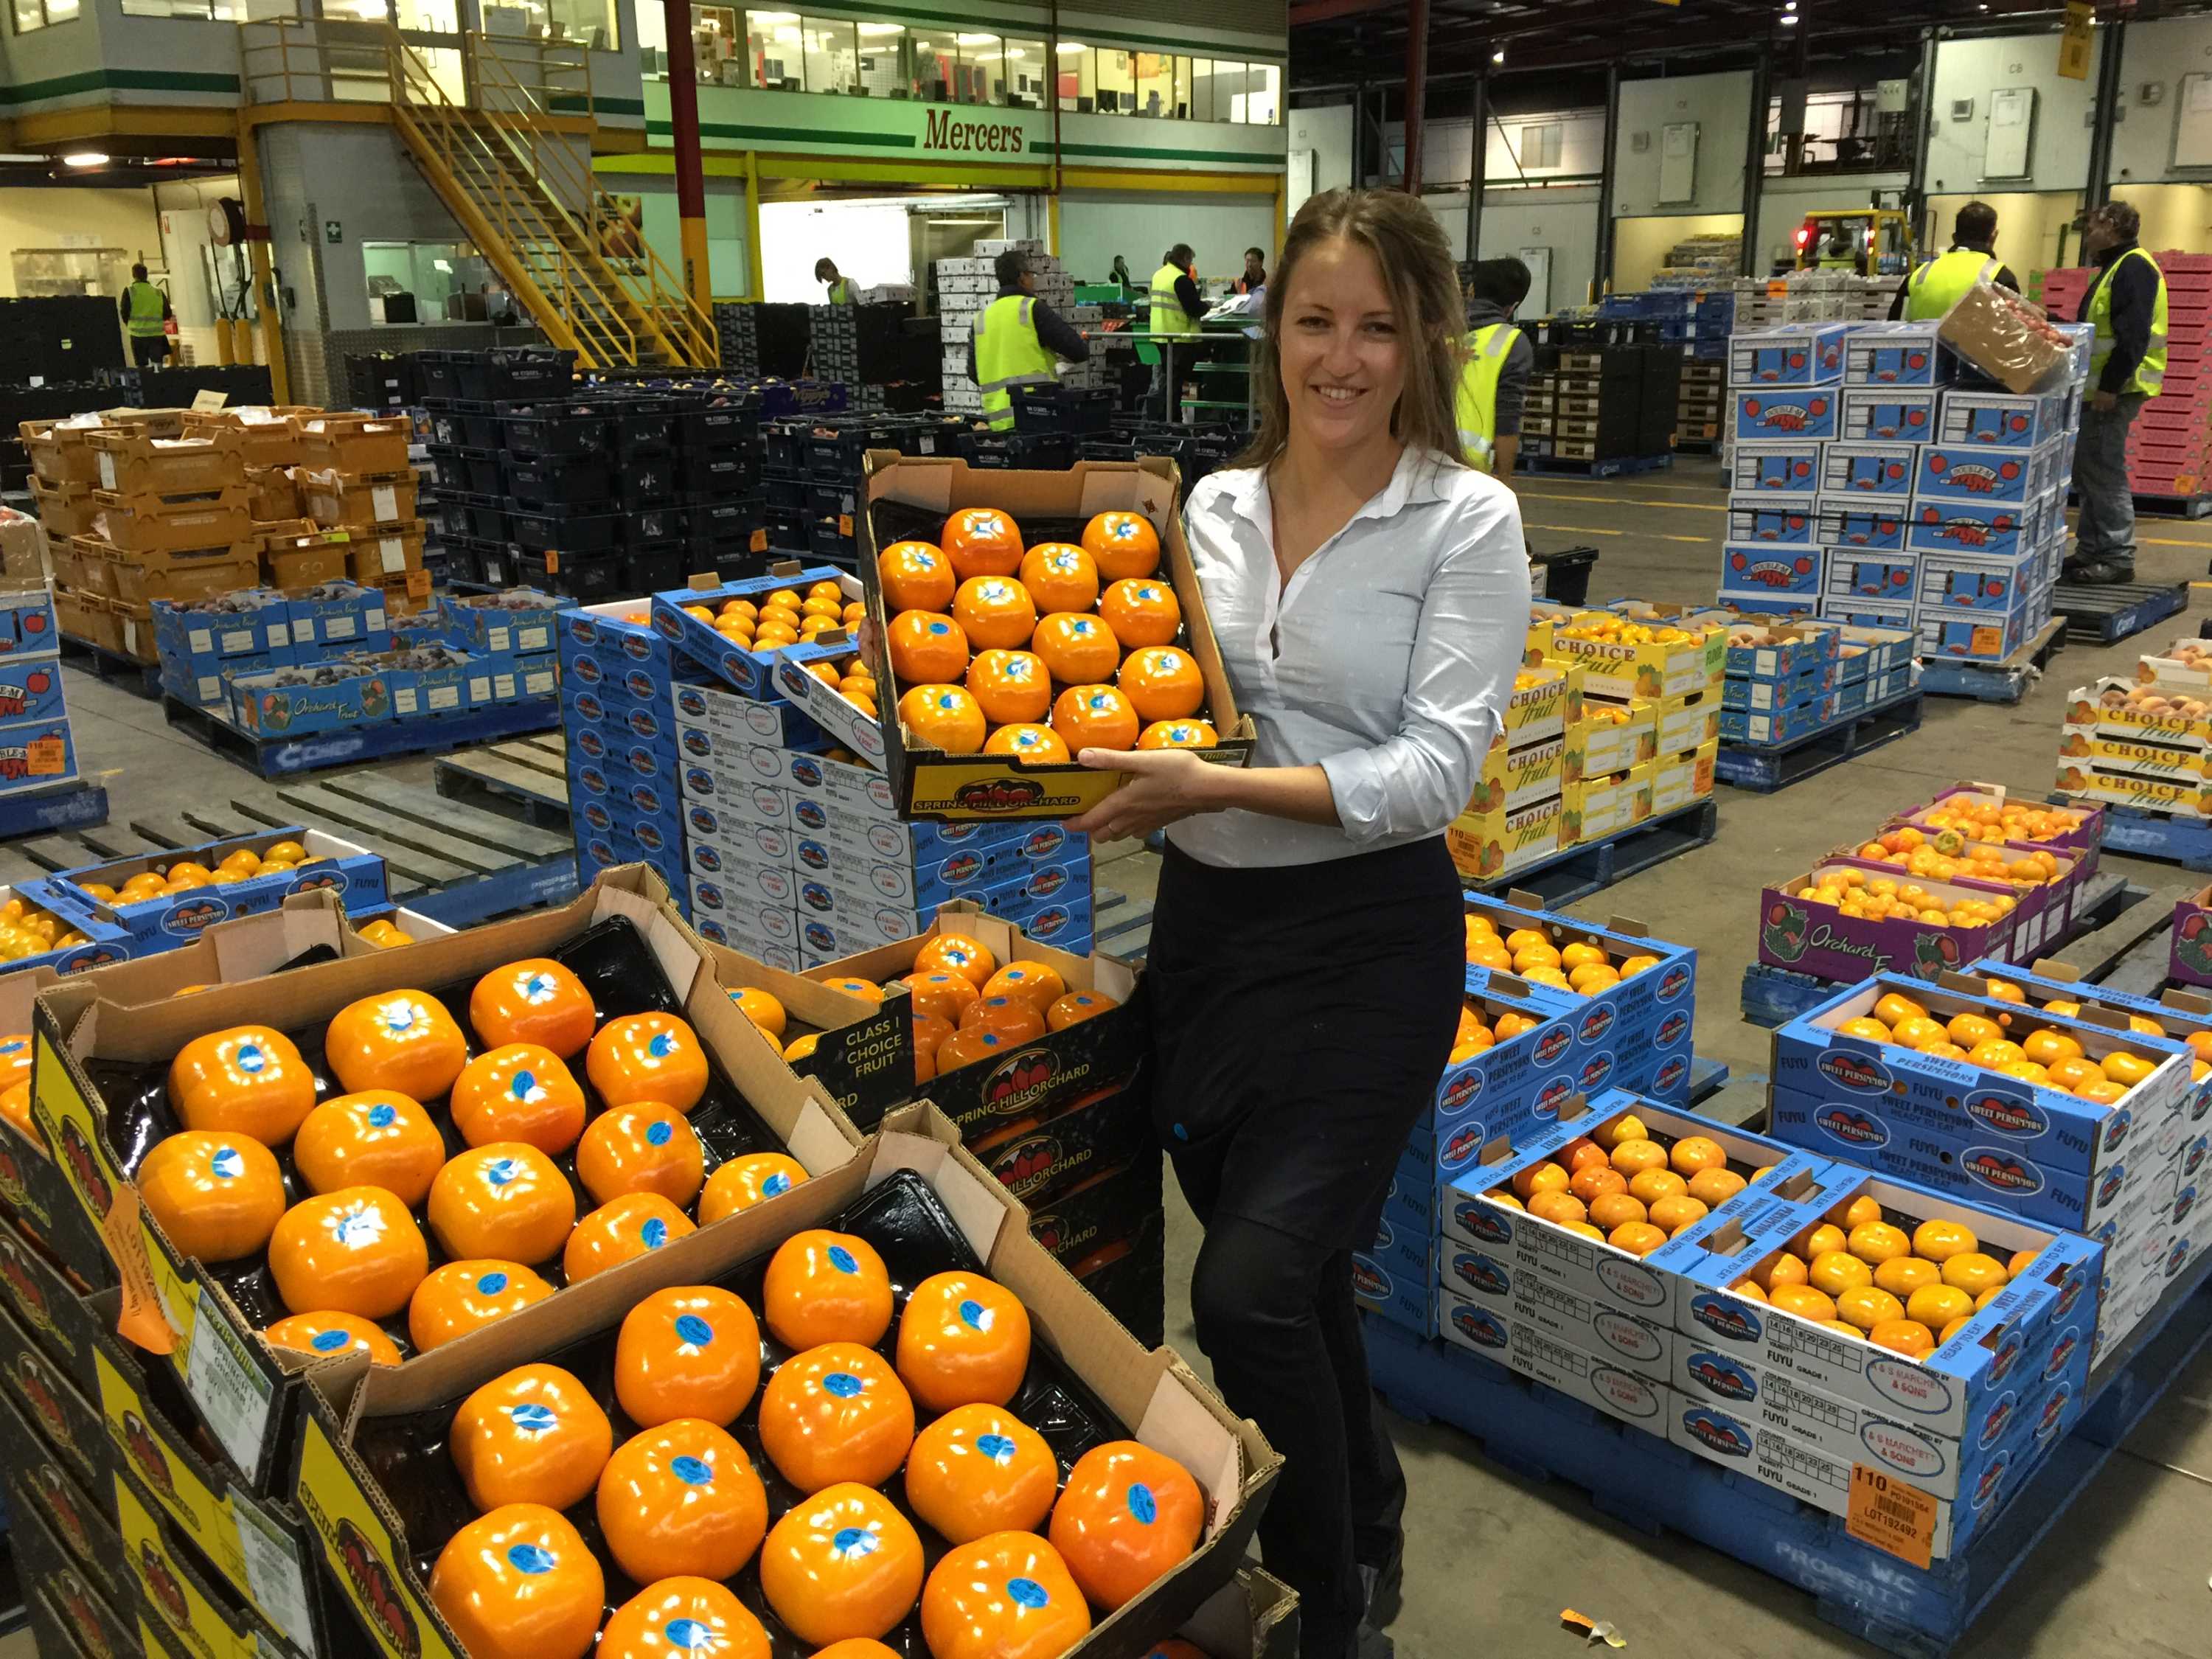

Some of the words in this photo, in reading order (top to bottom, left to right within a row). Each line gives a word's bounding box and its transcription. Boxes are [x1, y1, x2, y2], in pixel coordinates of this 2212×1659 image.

[923, 108, 1023, 153] Mercers
[1765, 406, 1805, 417] DOUBLE-M
[1752, 563, 1790, 574] DOUBLE-M
[1555, 639, 1636, 662] CHOICE
[1573, 652, 1623, 676] fruit
[1509, 682, 1565, 709] CHOICE
[295, 698, 337, 715] Orchard
[338, 703, 359, 720] Fruit
[1519, 698, 1556, 729] fruit
[2108, 709, 2195, 731] CHOICE
[1507, 743, 1562, 773] CHOICE
[2103, 742, 2189, 765] CHOICE
[1516, 759, 1554, 792] fruit
[2098, 776, 2185, 799] CHOICE
[914, 800, 970, 810] SPRING
[973, 799, 1004, 809] HILL
[1008, 796, 1080, 808] ORCHARD
[1506, 802, 1560, 834] CHOICE
[1450, 827, 1464, 840] 110
[1514, 818, 1551, 852] fruit
[355, 878, 379, 889] FUYU
[166, 915, 188, 929] SWEET
[189, 910, 225, 924] PERSIMMON
[1811, 925, 1876, 958] Orchard
[846, 1023, 891, 1047] CLASS
[896, 1016, 900, 1029] I
[846, 1034, 903, 1065] CHOICE
[1500, 1043, 1520, 1060] SWEET
[855, 1051, 896, 1079] FRUIT
[1781, 1057, 1809, 1070] FUYU
[1896, 1058, 1974, 1082] PERSIMMONS
[1923, 1056, 1963, 1071] SWEET
[1821, 1062, 1843, 1077] SWEET
[1845, 1069, 1888, 1088] PERSIMMON
[999, 1090, 1028, 1110] HILL
[1029, 1063, 1090, 1096] ORCHARD
[1441, 1094, 1455, 1107] SWEET
[1456, 1082, 1481, 1099] PERSIMMON
[1913, 1083, 1944, 1101] FUYU
[1882, 1095, 1911, 1110] SWEET
[1778, 1111, 1806, 1123] FUYU
[1970, 1105, 1994, 1119] SWEET
[1996, 1112, 2042, 1131] PERSIMMON
[1818, 1117, 1841, 1131] SWEET
[1843, 1125, 1885, 1144] PERSIMMON
[1910, 1138, 1940, 1157] FUYU
[2056, 1130, 2088, 1154] FUYU
[1032, 1148, 1092, 1184] ORCHARD
[1966, 1161, 1990, 1175] SWEET
[1991, 1169, 2037, 1189] PERSIMMON
[2051, 1188, 2082, 1212] FUYU
[1660, 1239, 1683, 1257] READY
[1517, 1251, 1537, 1267] FUYU
[2028, 1260, 2049, 1279] READY
[1623, 1285, 1645, 1301] SONS
[1992, 1290, 2020, 1310] SWEET
[1514, 1302, 1535, 1318] FUYU
[1770, 1312, 1796, 1325] COUNTS
[1617, 1338, 1639, 1349] SONS
[1770, 1320, 1778, 1329] 14
[1782, 1324, 1791, 1334] 16
[1795, 1329, 1804, 1339] 18
[1807, 1333, 1817, 1343] 20
[1819, 1338, 1829, 1349] 23
[1832, 1343, 1842, 1353] 25
[1767, 1350, 1793, 1368] FUYU
[1940, 1340, 1962, 1360] READY
[1512, 1355, 1533, 1371] FUYU
[1796, 1365, 1823, 1380] GRADE
[1765, 1371, 1792, 1385] COUNTS
[1616, 1391, 1638, 1404] SONS
[1765, 1379, 1774, 1389] 14
[1777, 1383, 1787, 1394] 16
[1790, 1388, 1799, 1398] 18
[1801, 1393, 1812, 1403] 20
[1814, 1398, 1825, 1408] 23
[1827, 1403, 1837, 1413] 25
[1901, 1382, 1927, 1399] SONS
[1762, 1408, 1788, 1427] FUYU
[1759, 1429, 1786, 1443] COUNTS
[1791, 1425, 1818, 1439] GRADE
[1759, 1436, 1769, 1445] 14
[1772, 1441, 1781, 1451] 16
[1784, 1446, 1794, 1456] 18
[1795, 1451, 1806, 1461] 20
[1808, 1456, 1818, 1467] 23
[1820, 1461, 1832, 1472] 25
[1890, 1450, 1916, 1468] SONS
[1757, 1464, 1783, 1484] FUYU
[1854, 1467, 1887, 1492] 110
[1787, 1481, 1812, 1497] GRADE
[1865, 1506, 1917, 1539] LOT192492
